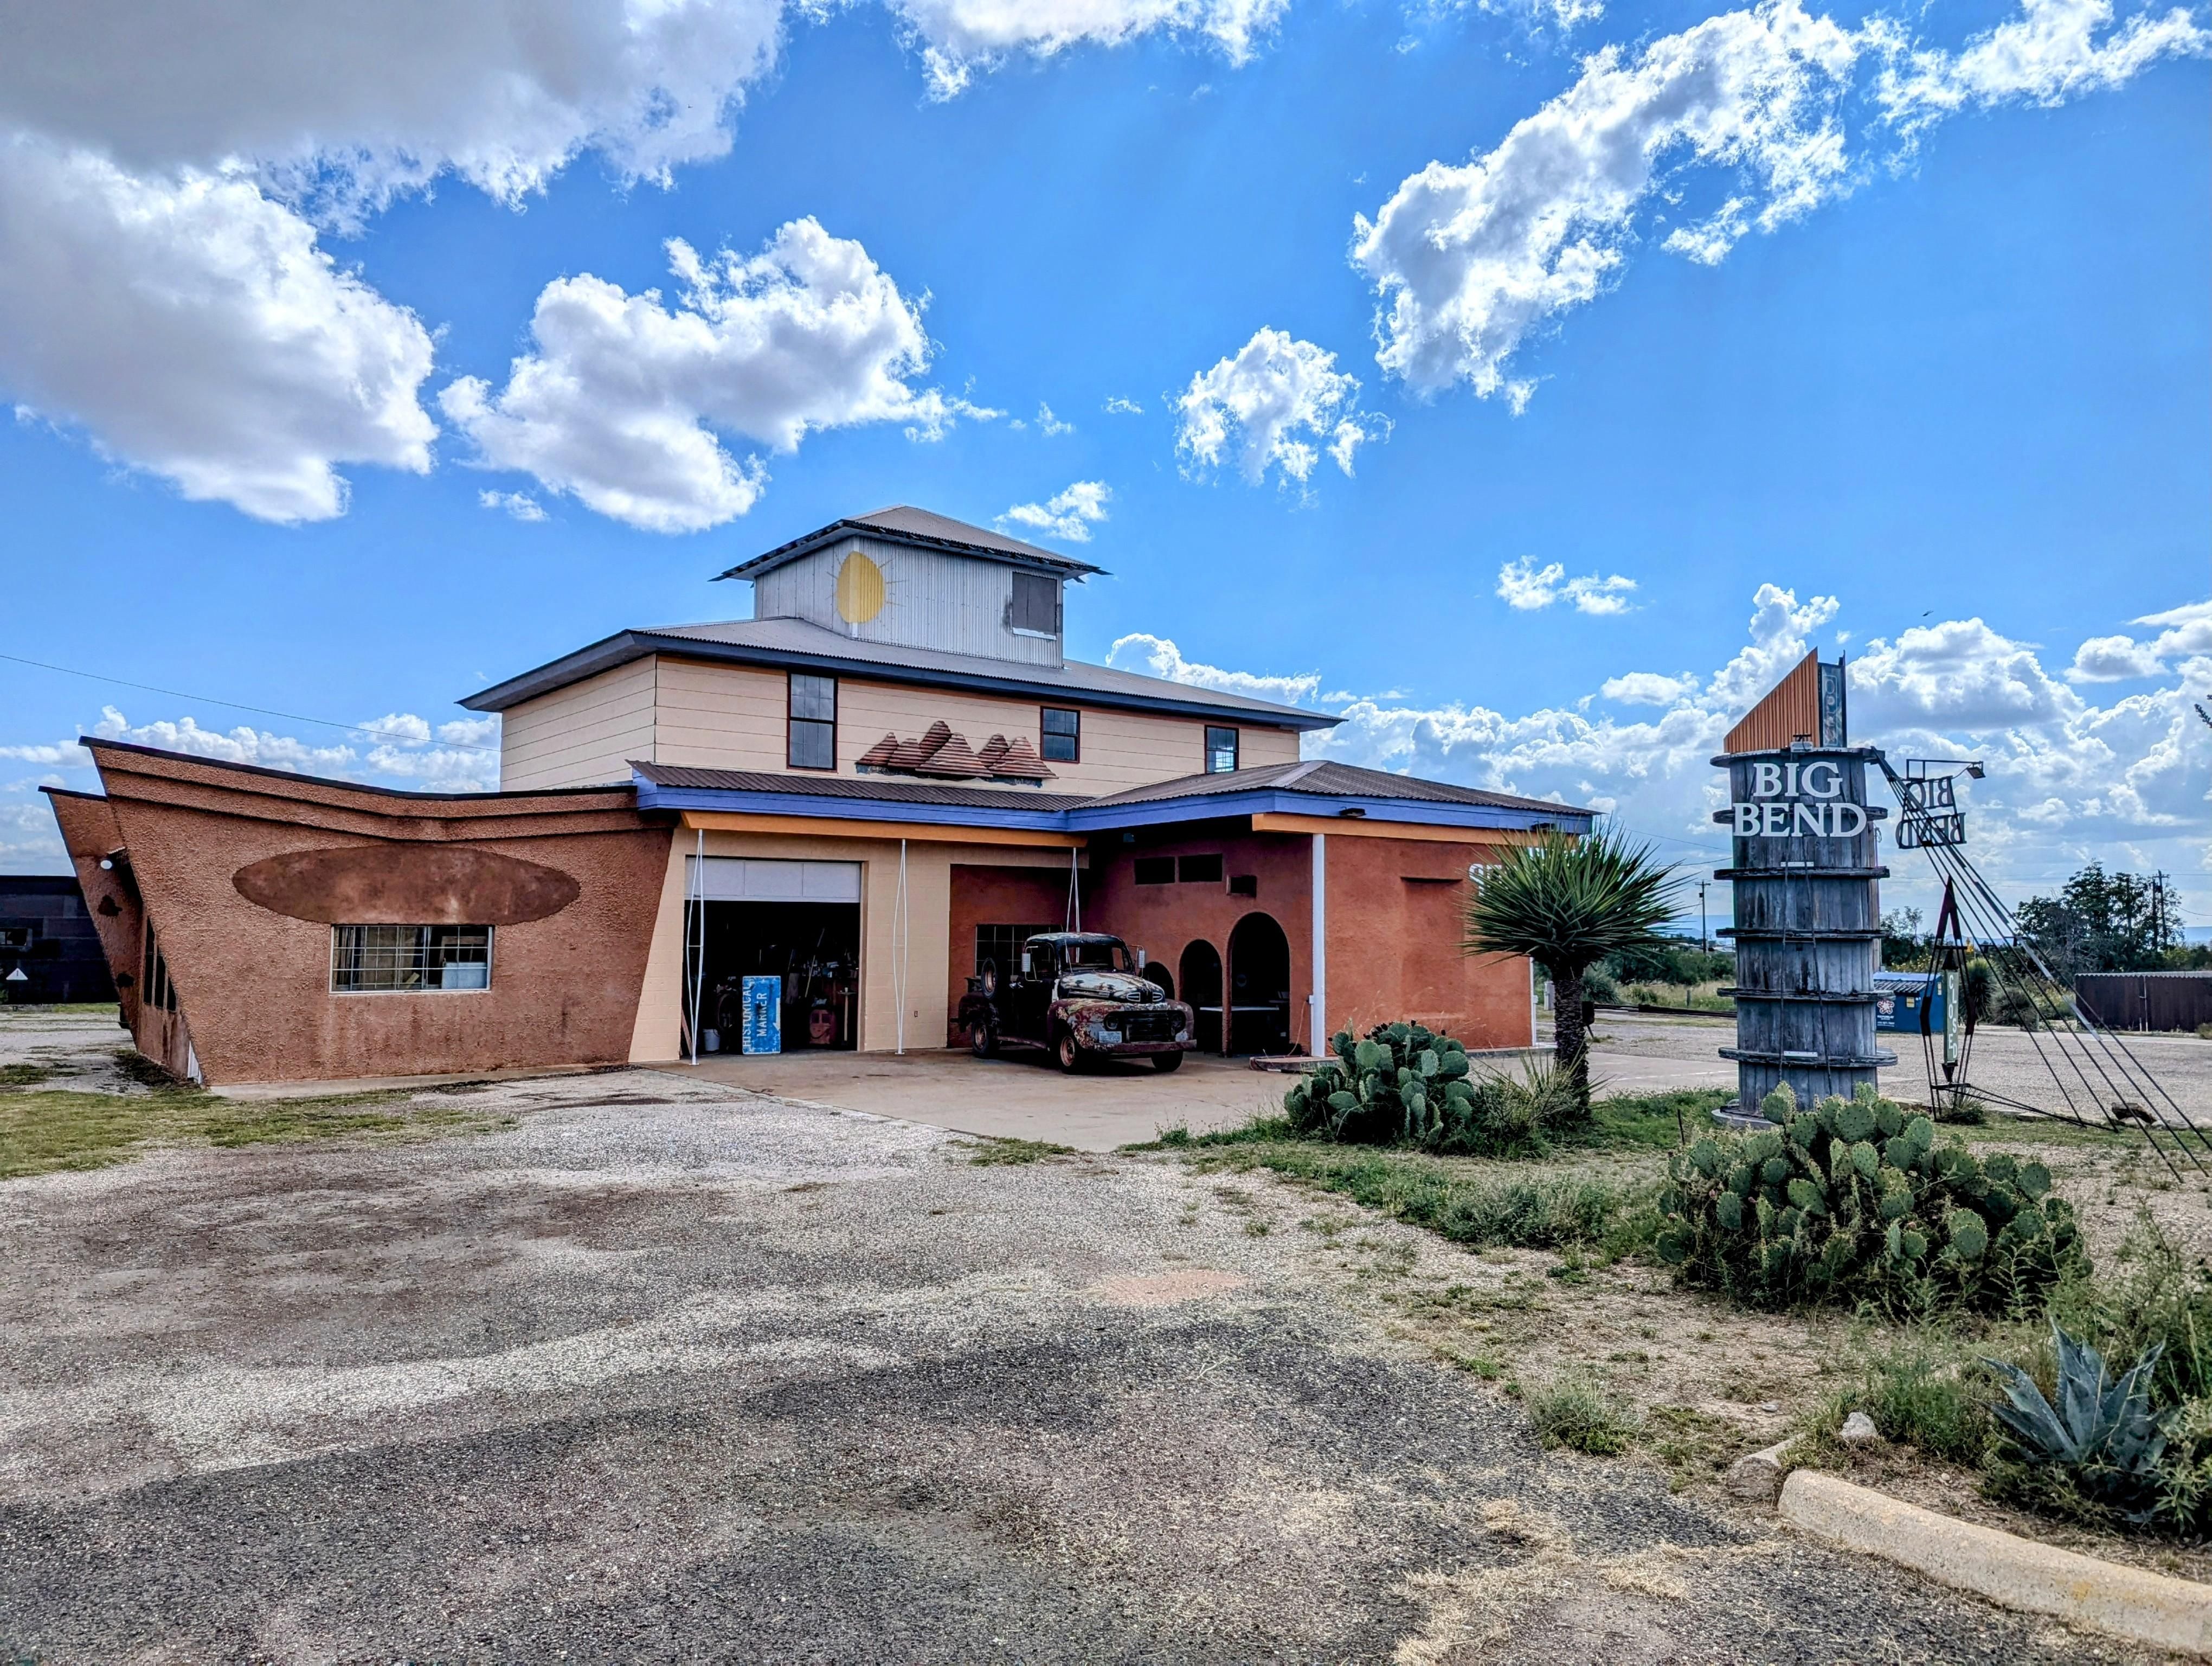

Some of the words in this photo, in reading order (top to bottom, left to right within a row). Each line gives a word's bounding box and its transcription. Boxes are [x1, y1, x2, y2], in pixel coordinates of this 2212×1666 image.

[1753, 761, 1843, 798] BIG
[1733, 803, 1867, 837] BEND
[743, 984, 751, 1047] HISTORICAL
[756, 993, 767, 1037] MARKER
[1949, 975, 1958, 1058] CLOSED
